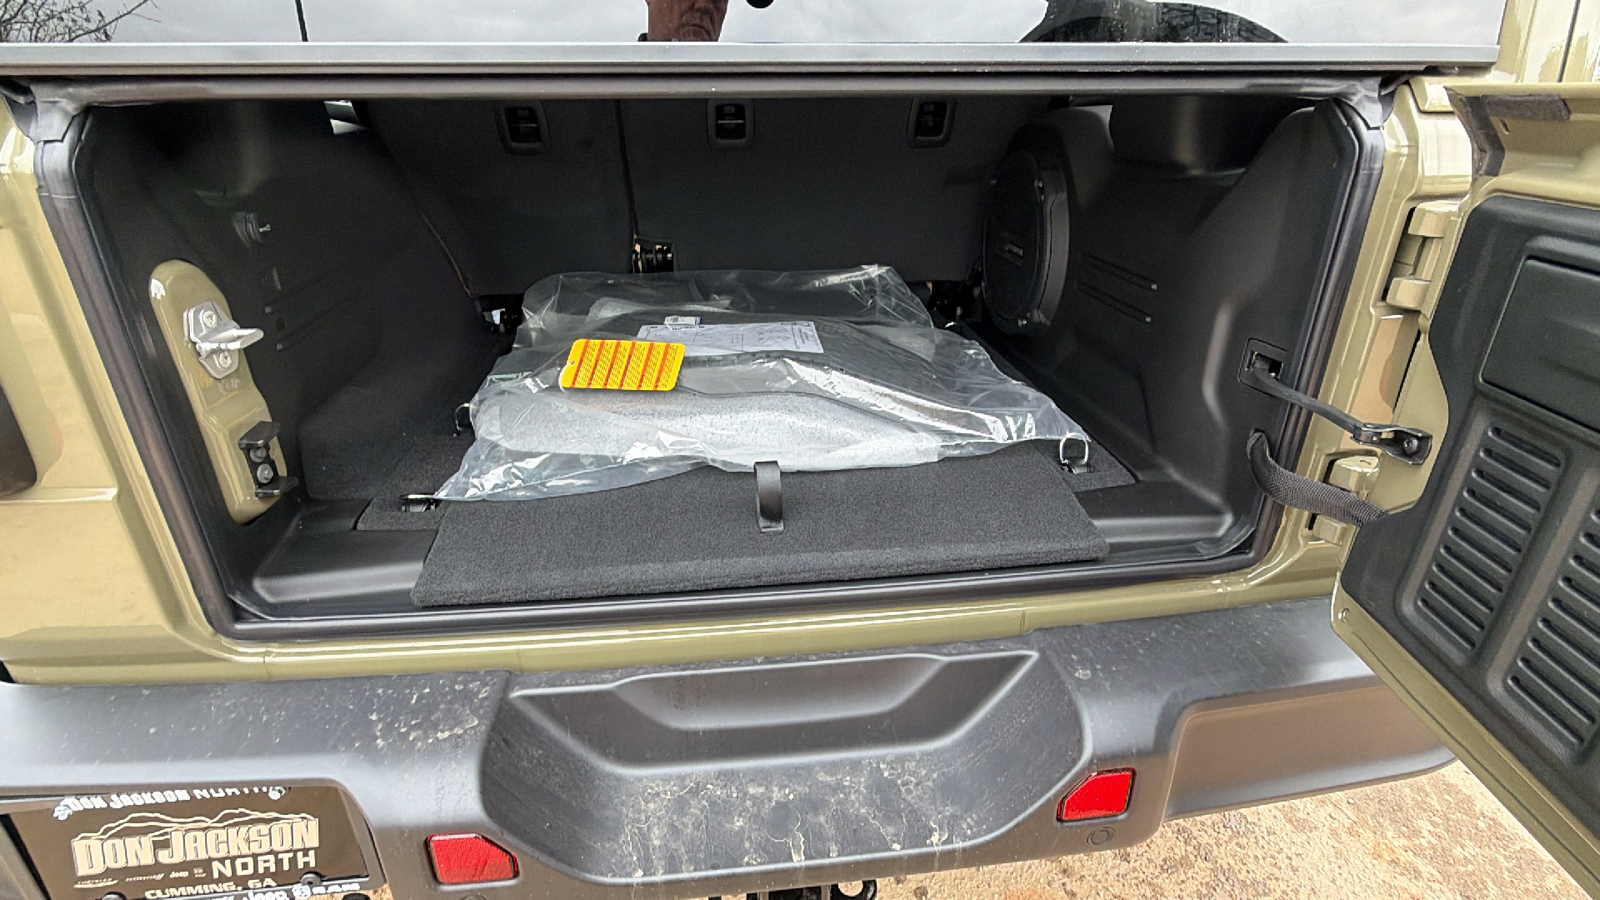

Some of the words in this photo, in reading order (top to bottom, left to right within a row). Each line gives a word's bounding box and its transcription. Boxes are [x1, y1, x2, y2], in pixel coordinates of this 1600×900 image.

[70, 796, 107, 812] DON
[109, 789, 191, 809] JACKSON
[72, 834, 156, 877] DON
[156, 817, 321, 864] JACKSON
[211, 849, 316, 879] NORTH
[144, 881, 243, 900] CUMMING,
[247, 878, 277, 889] GA
